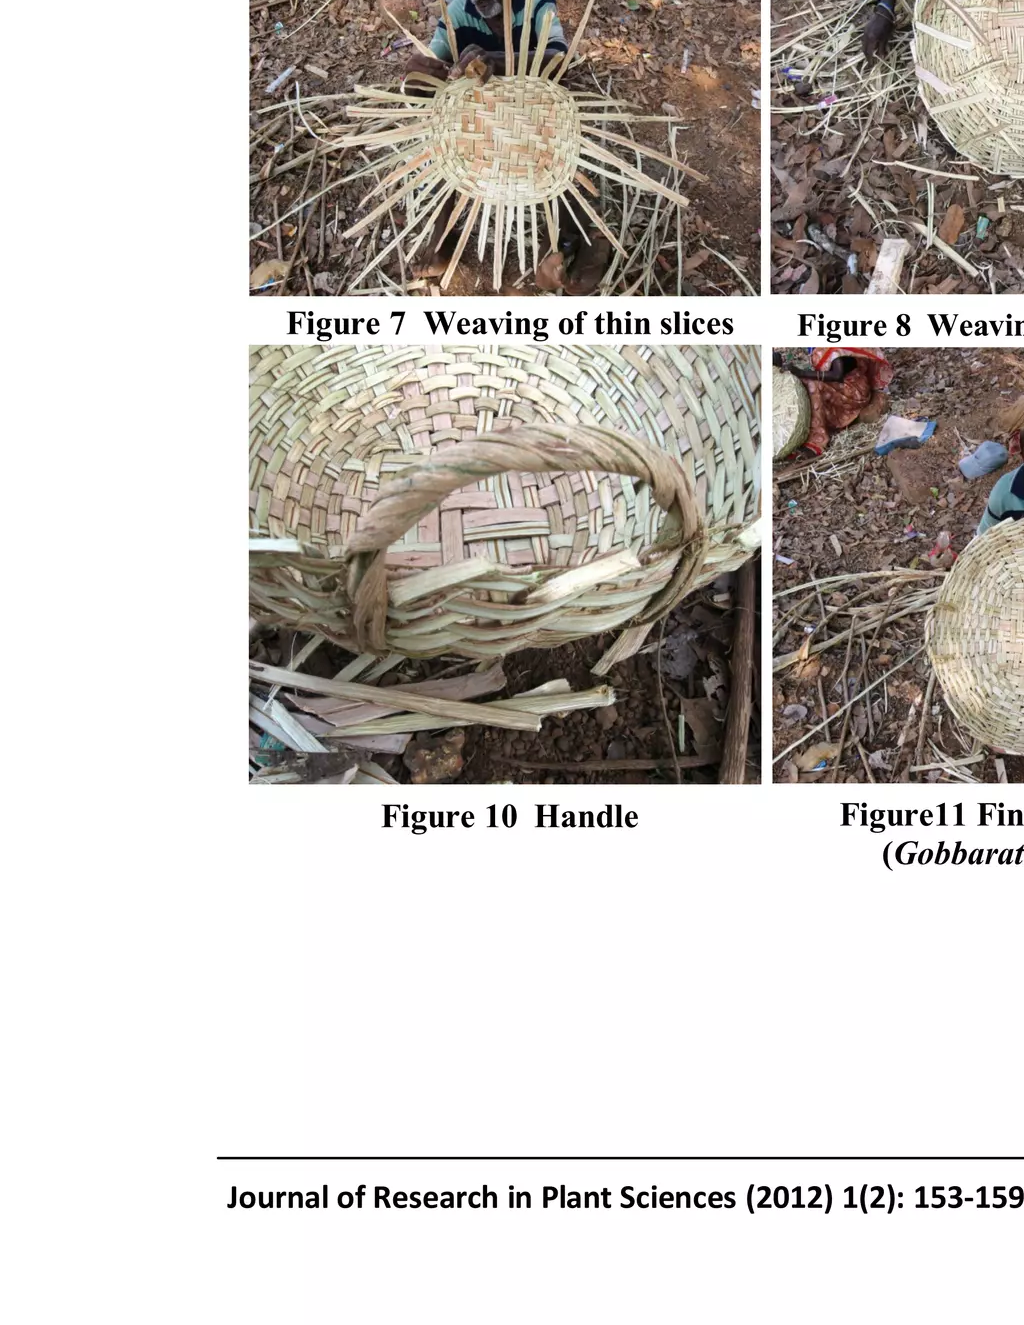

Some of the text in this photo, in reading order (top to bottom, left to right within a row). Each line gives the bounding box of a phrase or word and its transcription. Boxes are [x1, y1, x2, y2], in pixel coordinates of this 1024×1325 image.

[286, 310, 734, 342] Figure 7 Weaving of thin slices
[797, 313, 887, 344] Figure
[895, 313, 911, 337] 8
[381, 803, 639, 836] Figure 10 Handle
[839, 802, 966, 834] Figure11
[226, 1183, 1024, 1215] Journal of Research in Plant Sciences (2012) 1(2): 153-159
